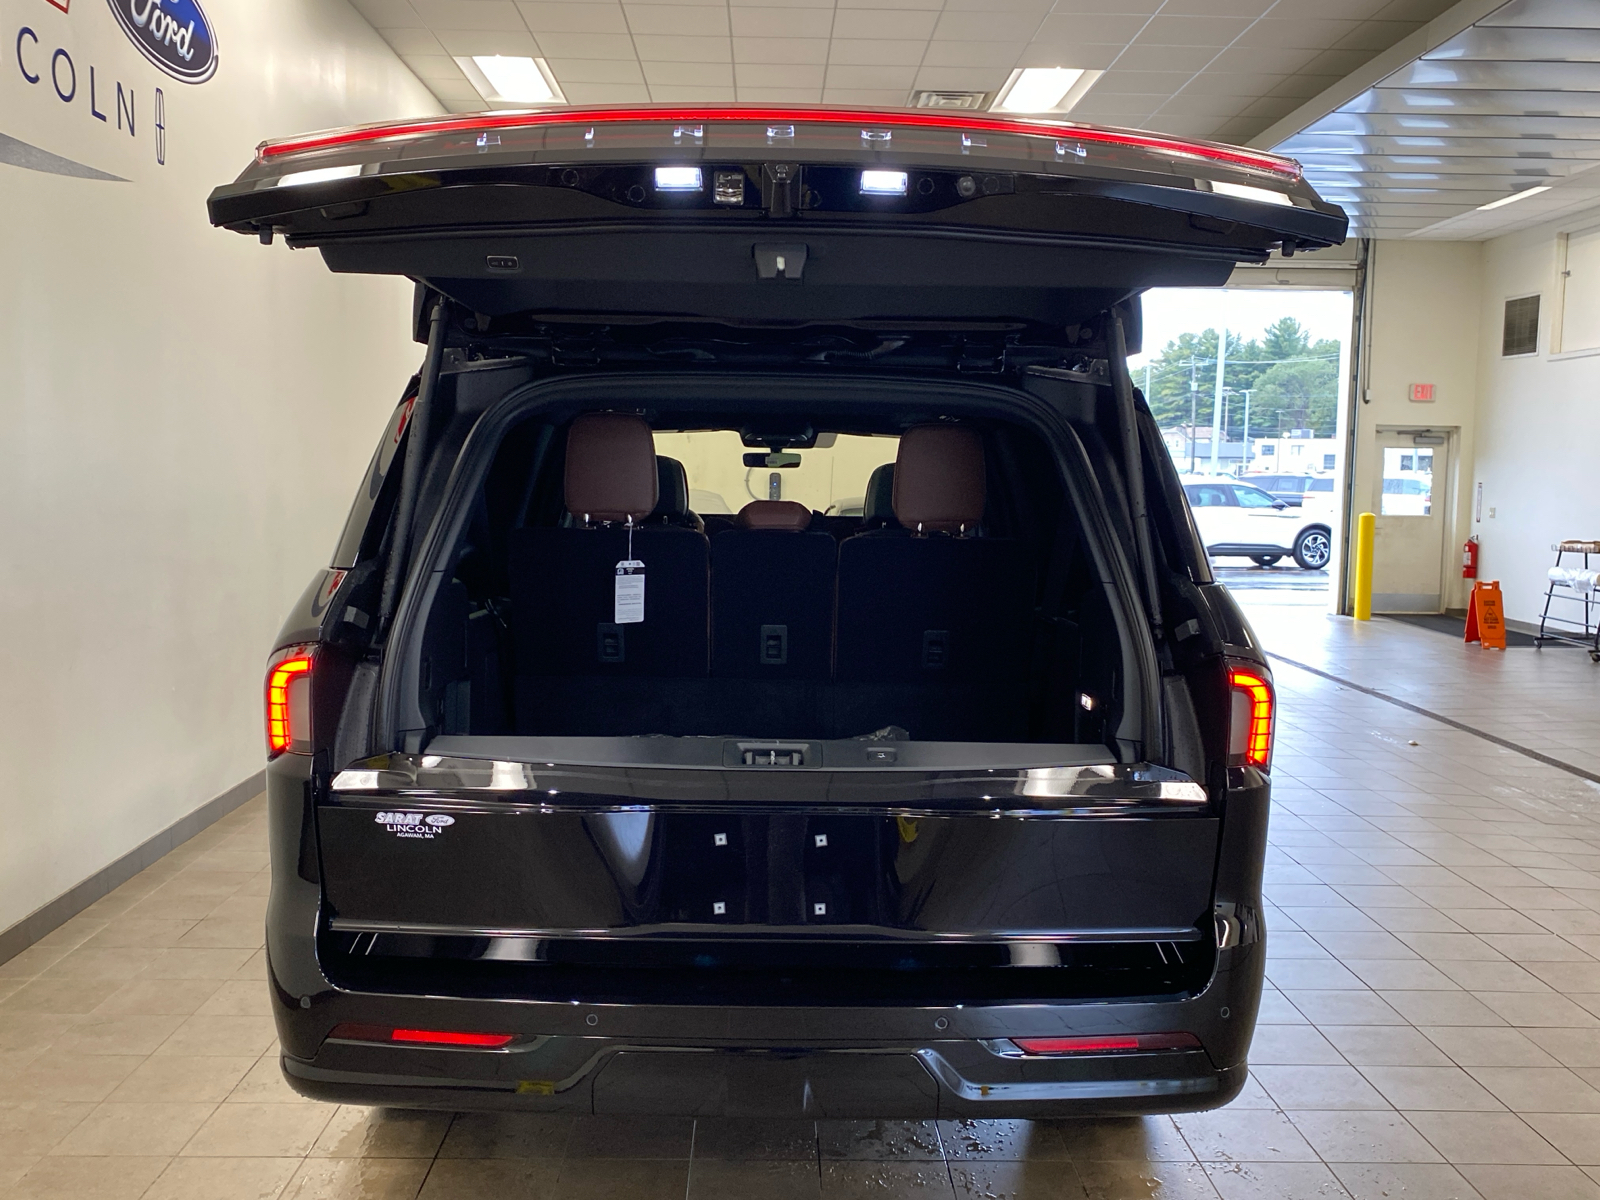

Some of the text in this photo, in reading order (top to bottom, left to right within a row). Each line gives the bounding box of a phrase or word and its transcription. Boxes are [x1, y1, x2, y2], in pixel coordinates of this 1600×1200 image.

[1414, 383, 1433, 400] EXIT
[375, 812, 450, 825] SARAT Ford
[387, 824, 442, 833] LINCOLN
